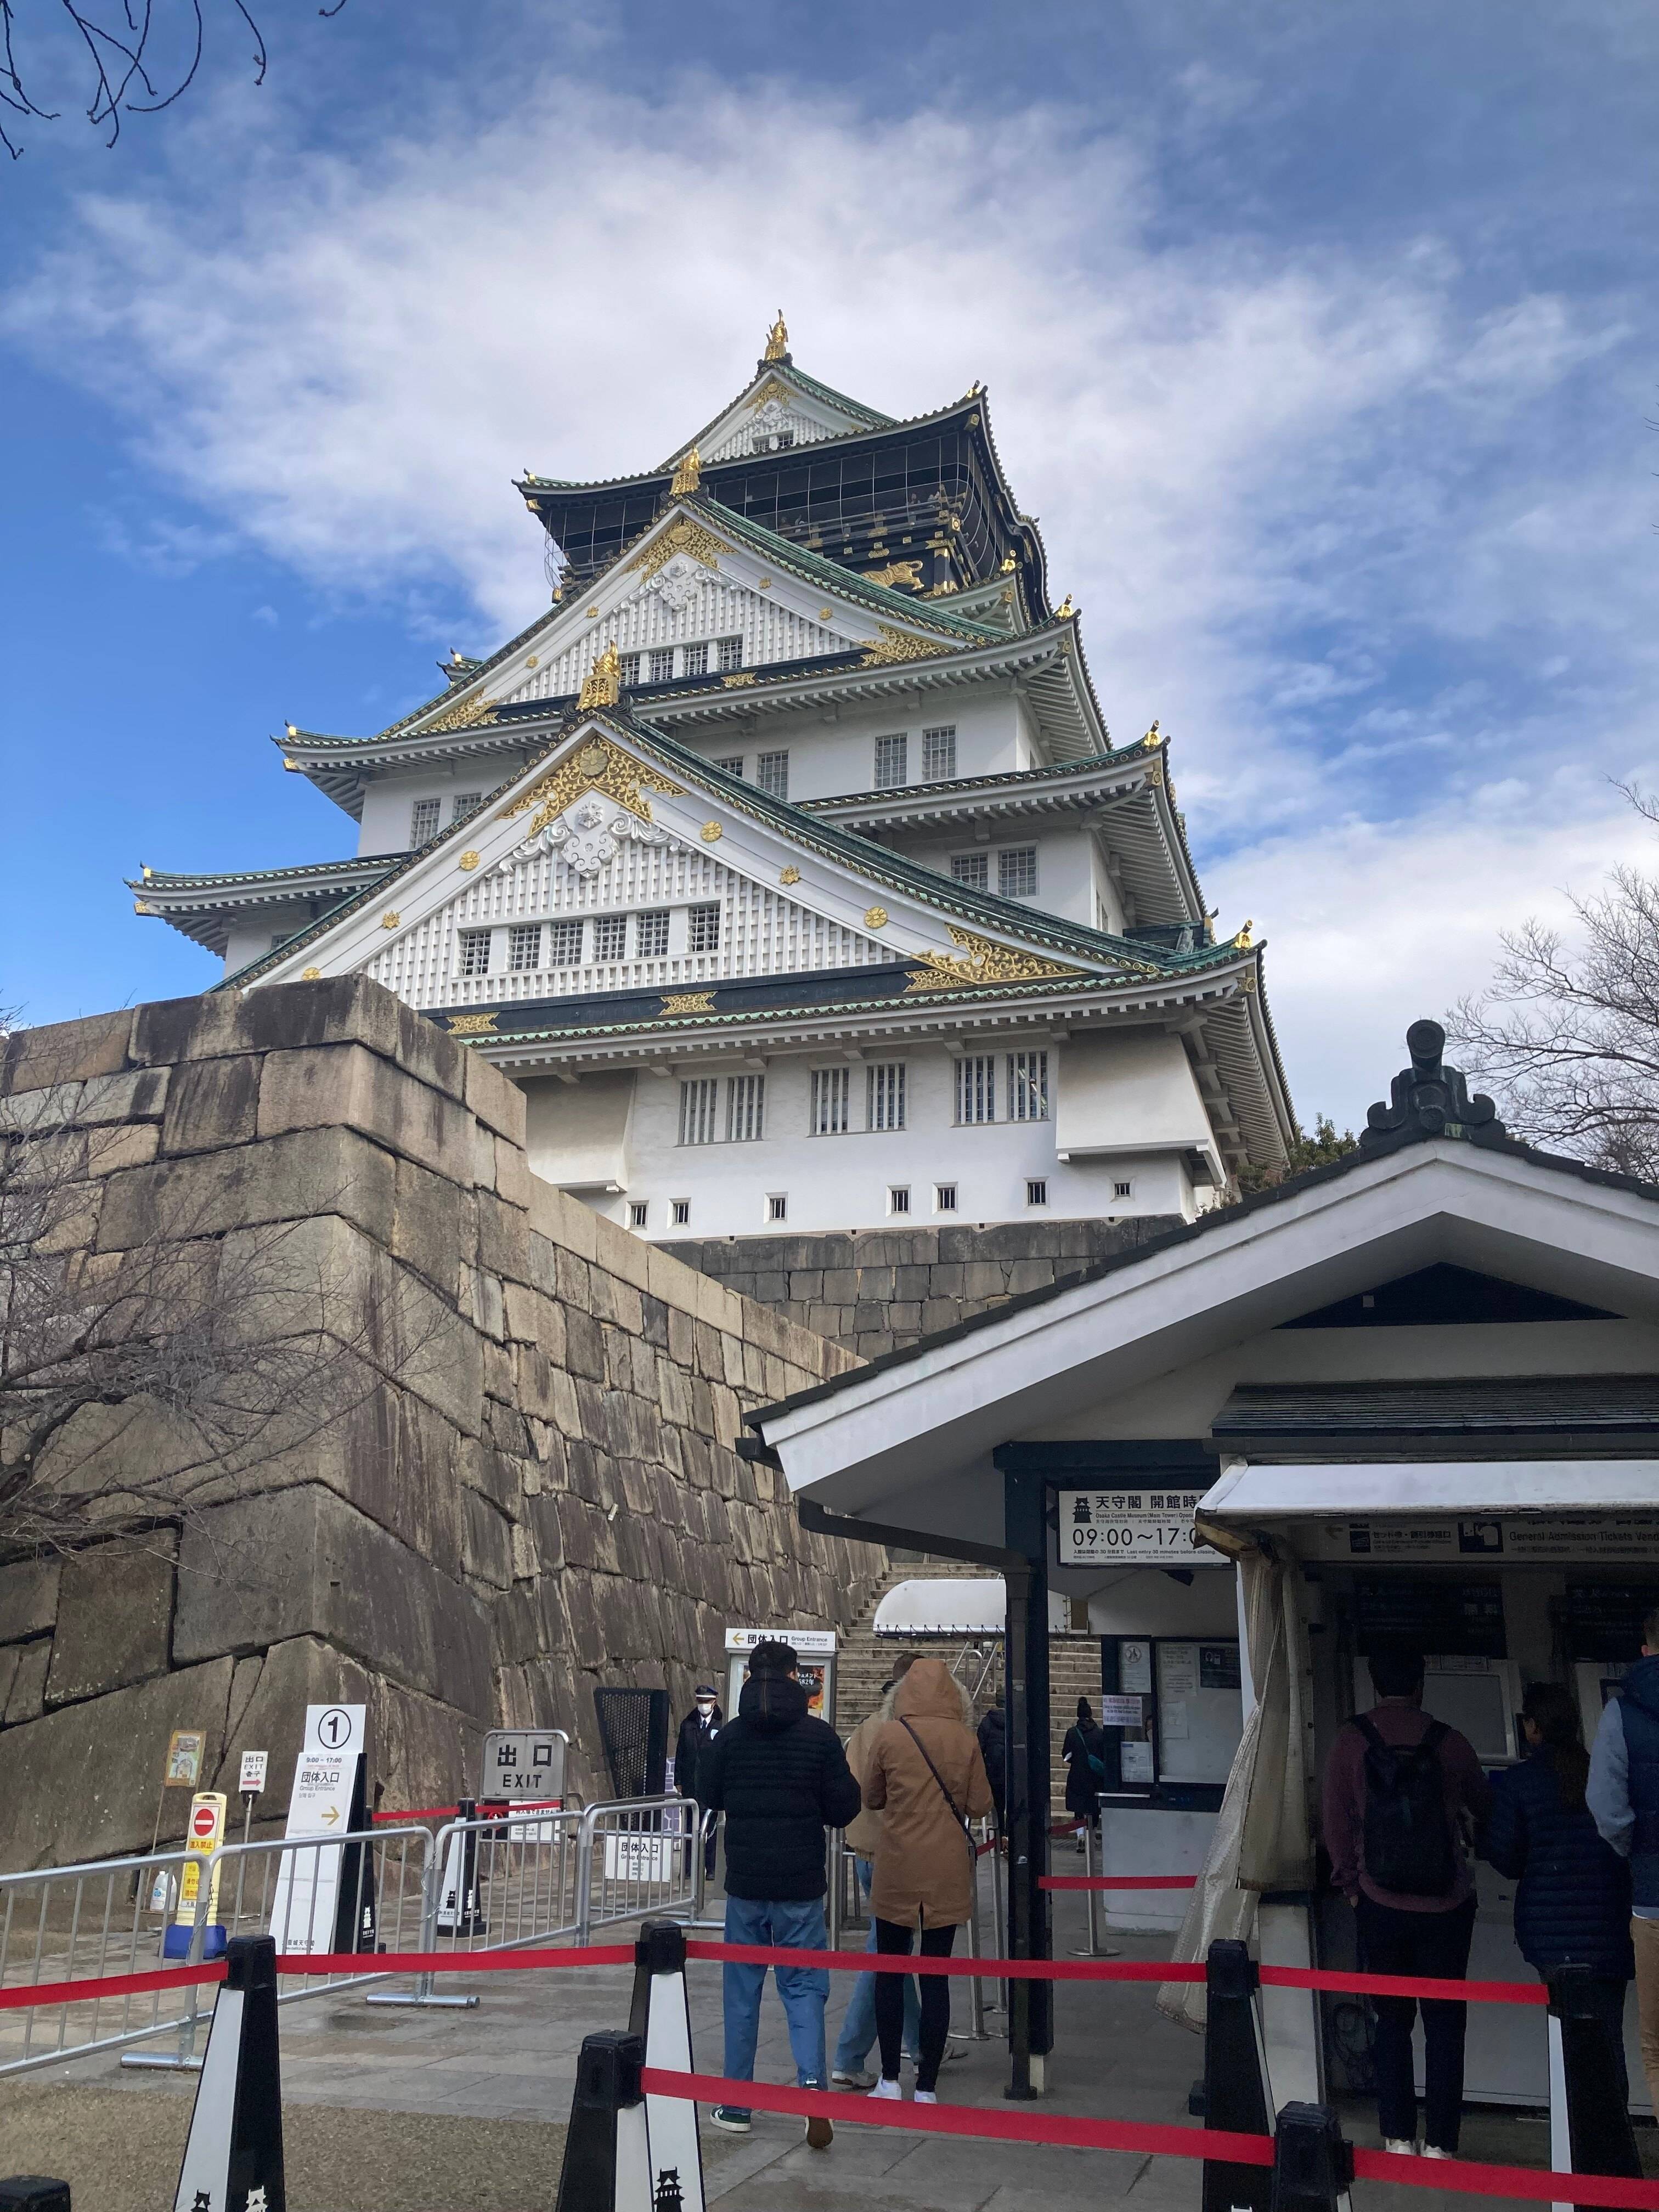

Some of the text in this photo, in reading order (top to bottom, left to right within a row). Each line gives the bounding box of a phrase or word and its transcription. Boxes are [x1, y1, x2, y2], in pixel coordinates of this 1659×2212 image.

[1096, 1495, 1205, 1509] 天守閣 開館時
[1510, 1531, 1545, 1541] General
[498, 1745, 552, 1767] 出口
[301, 1771, 340, 1783] 団体入口
[503, 1774, 541, 1788] EXIT
